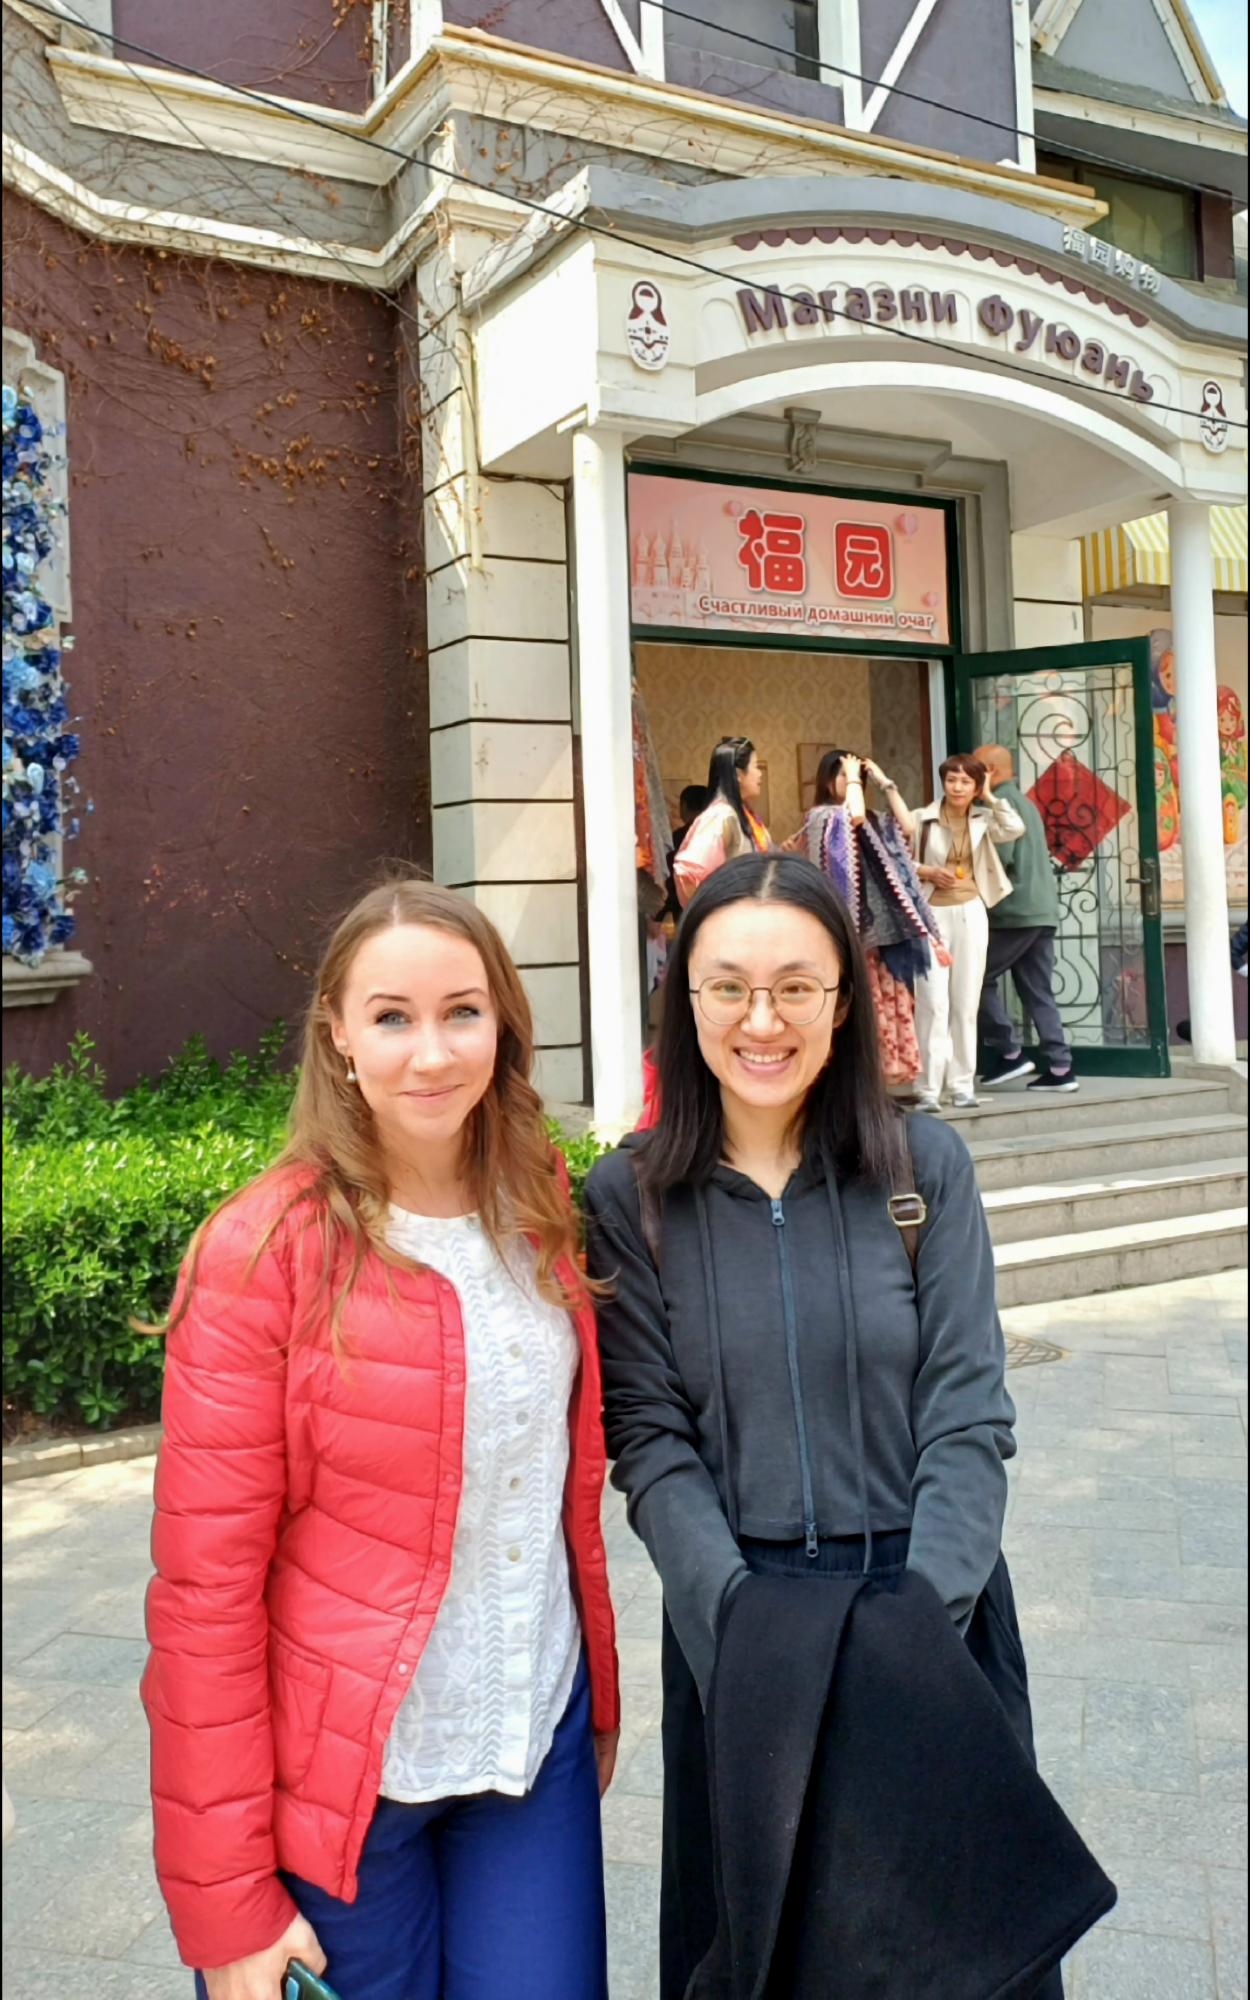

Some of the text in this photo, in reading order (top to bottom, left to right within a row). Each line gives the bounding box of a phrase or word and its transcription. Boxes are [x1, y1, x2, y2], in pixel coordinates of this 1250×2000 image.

[736, 284, 1154, 402] Магазни Фуюань
[738, 508, 894, 598] 福园
[699, 595, 934, 627] Счастливый домашний очаг
